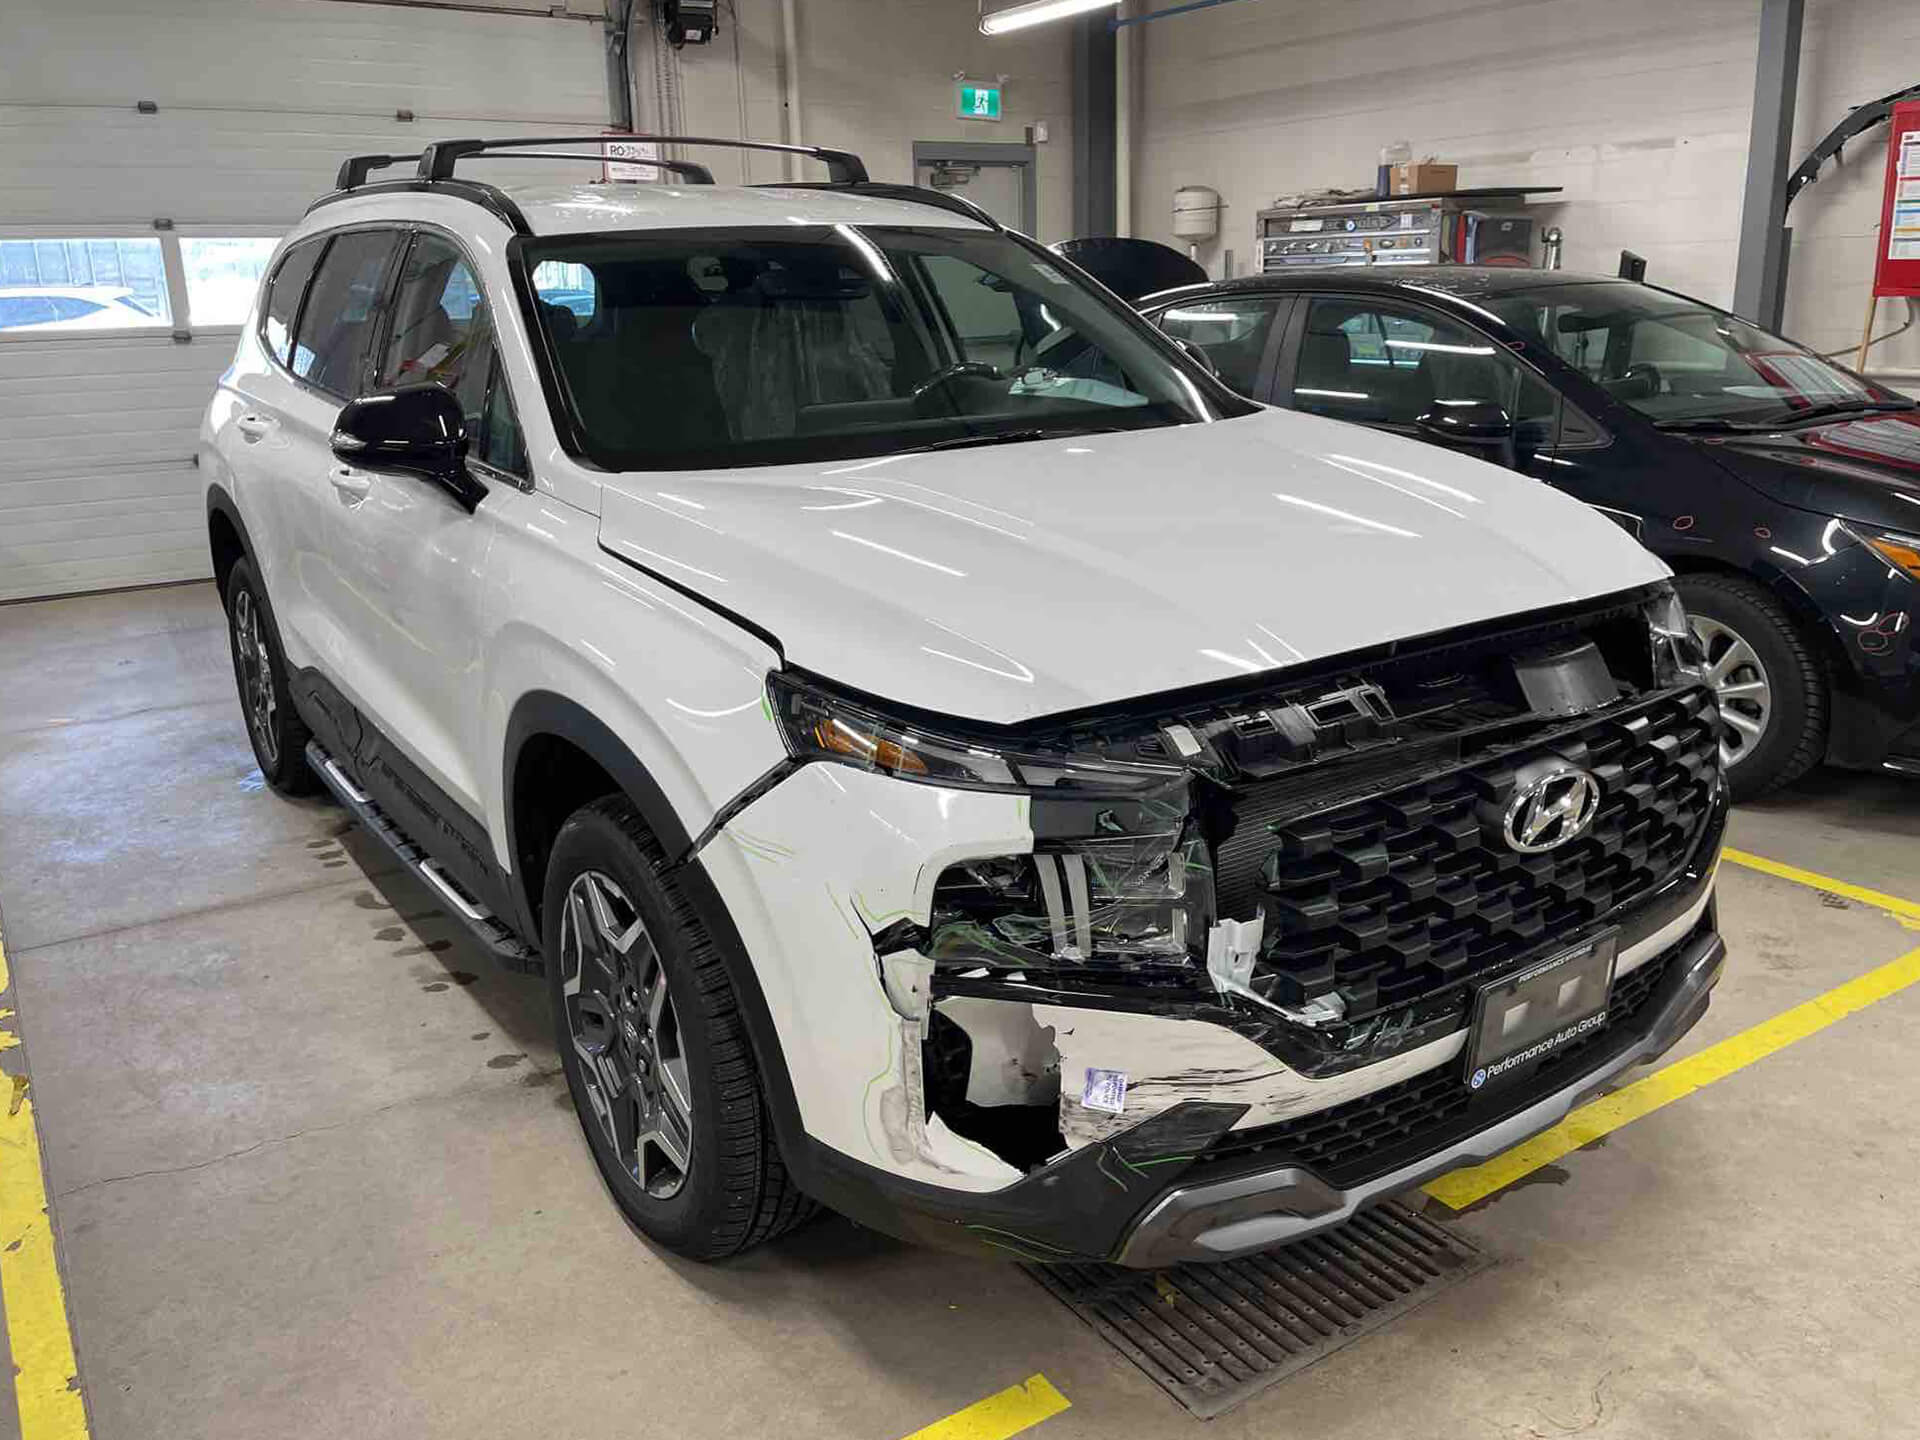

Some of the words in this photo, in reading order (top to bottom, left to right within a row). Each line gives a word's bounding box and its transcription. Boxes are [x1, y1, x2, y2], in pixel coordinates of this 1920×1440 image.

[1487, 1038, 1554, 1079] Performance
[1554, 1026, 1577, 1046] Auto
[1578, 1011, 1606, 1033] Group
